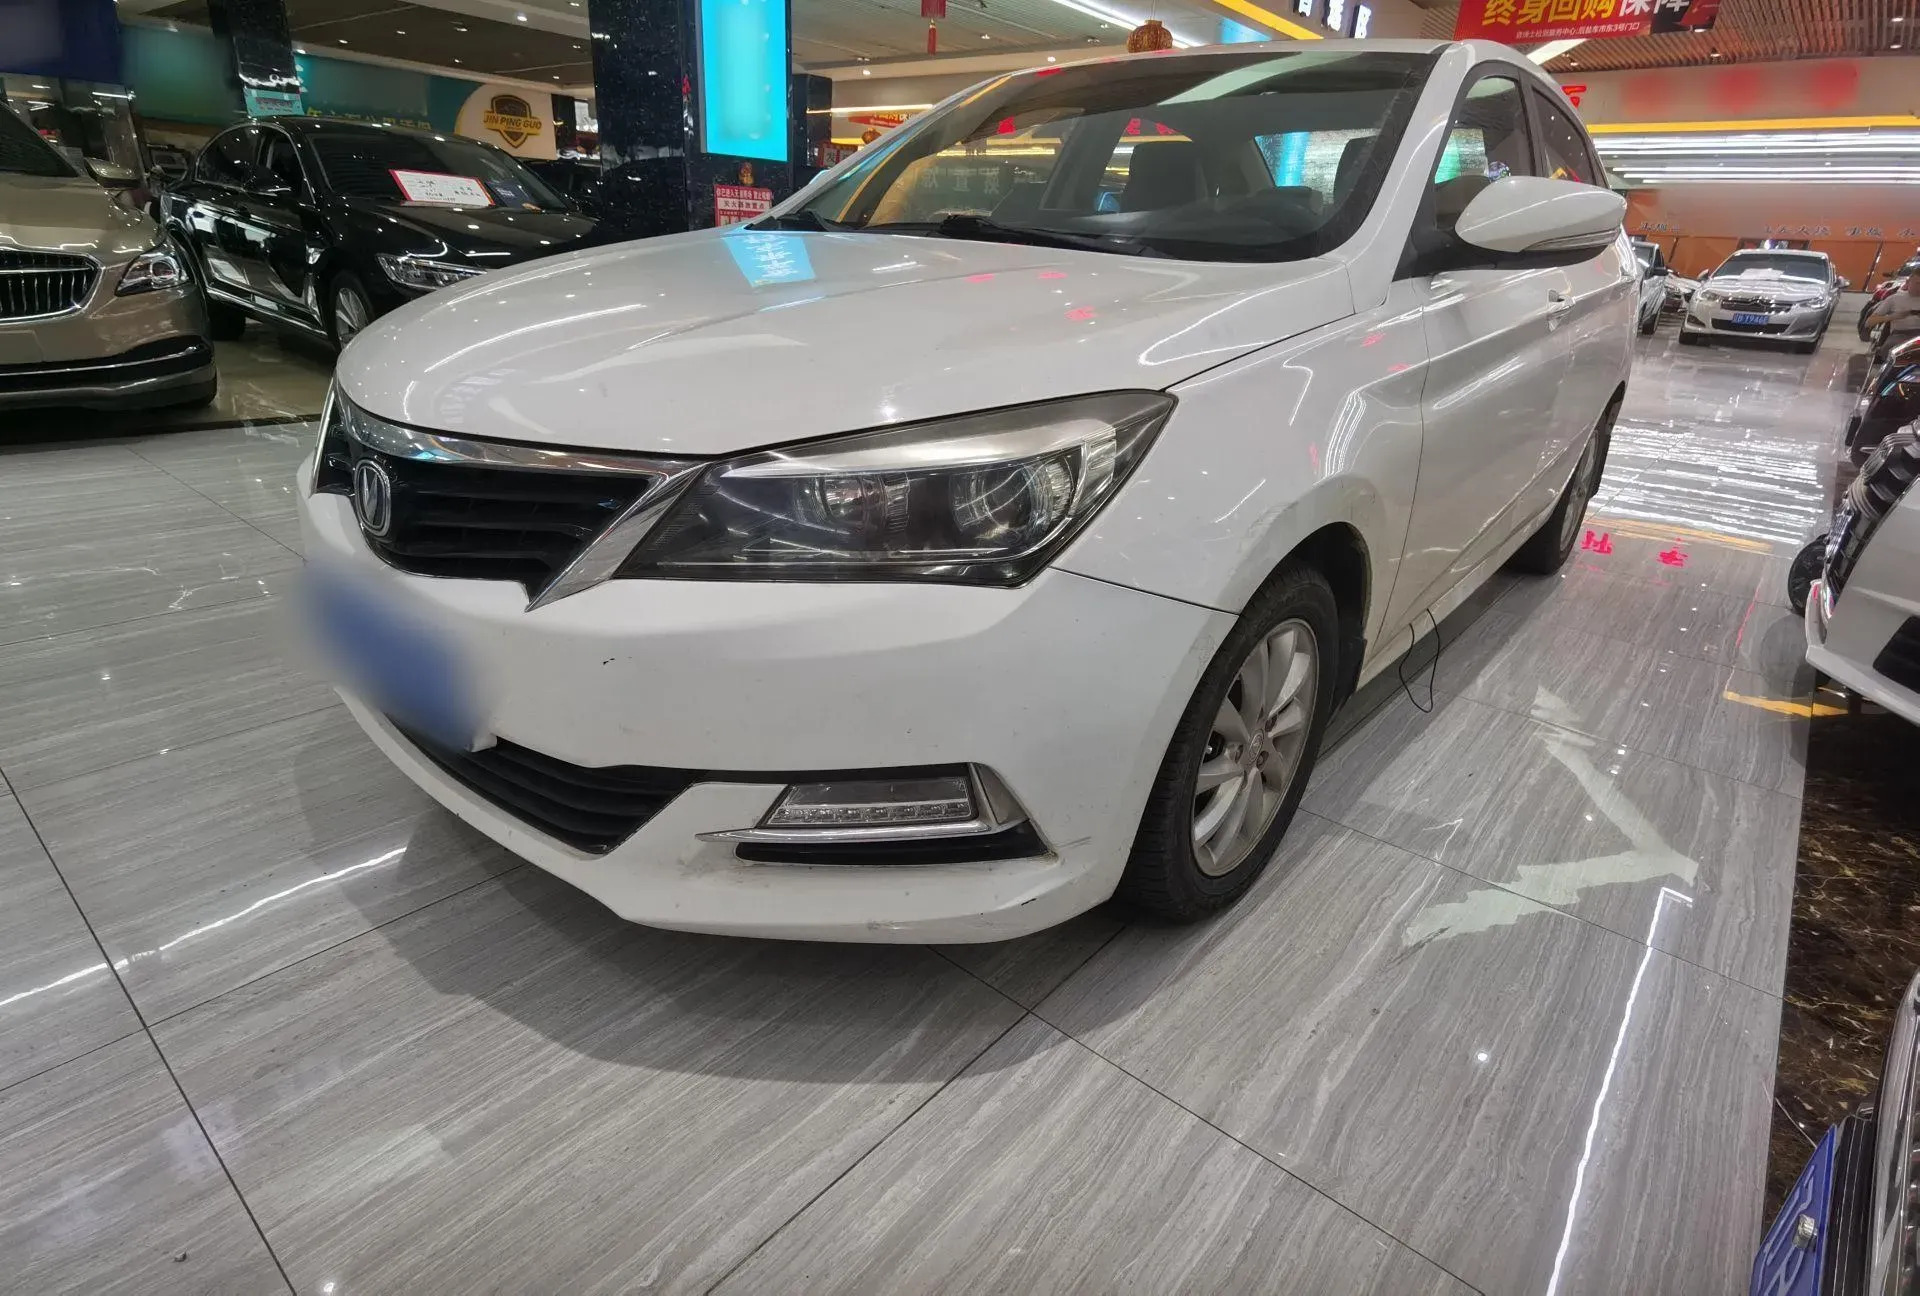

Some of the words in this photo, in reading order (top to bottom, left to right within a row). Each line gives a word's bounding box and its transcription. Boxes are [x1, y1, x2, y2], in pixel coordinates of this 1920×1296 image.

[483, 113, 499, 124] JIN
[500, 116, 521, 128] PING
[523, 118, 542, 130] GUO
